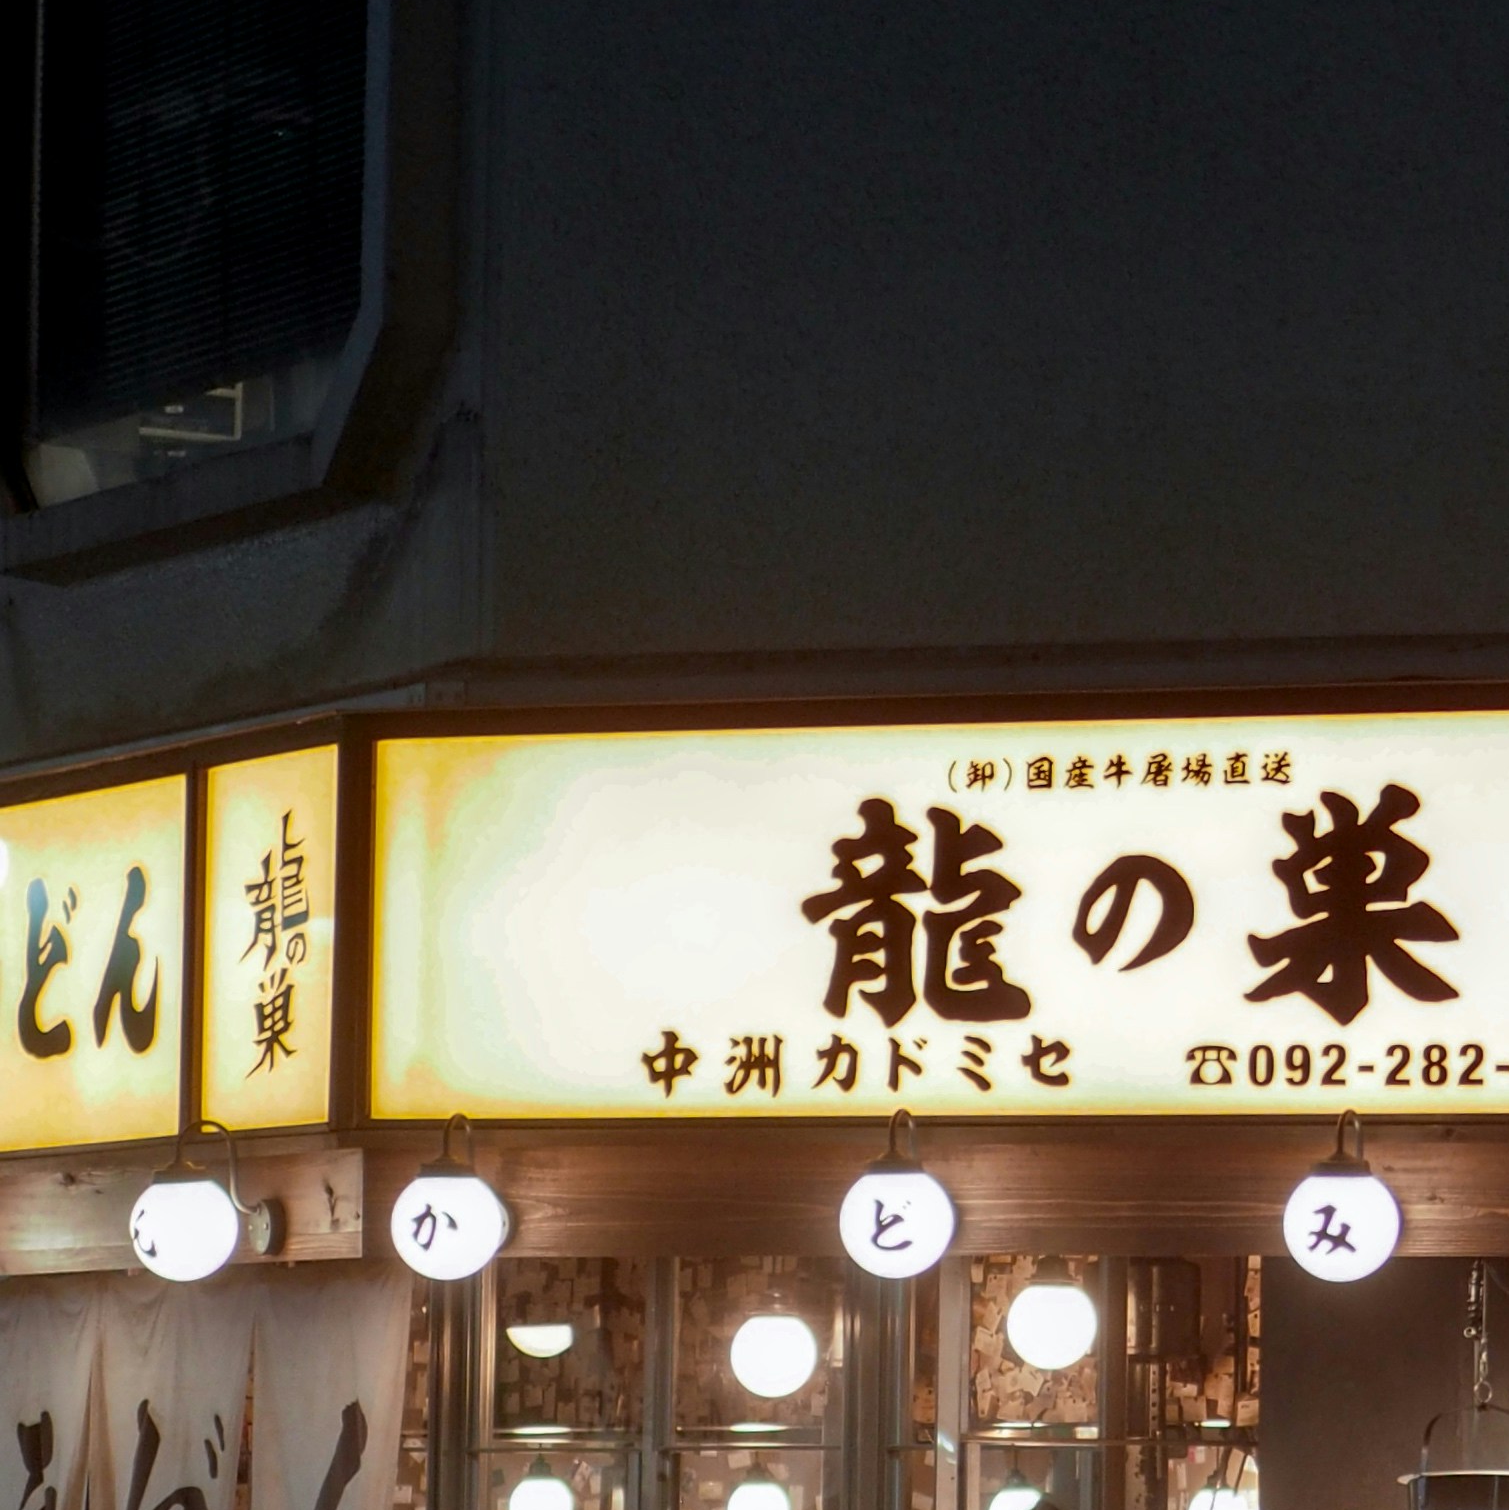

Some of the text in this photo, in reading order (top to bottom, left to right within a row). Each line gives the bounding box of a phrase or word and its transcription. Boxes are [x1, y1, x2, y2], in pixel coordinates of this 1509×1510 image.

[17, 865, 159, 1059] どん
[240, 809, 310, 1079] 龍の巣
[801, 783, 1461, 1028] 龍の巣
[641, 1031, 1072, 1097] 中洲カドミセ
